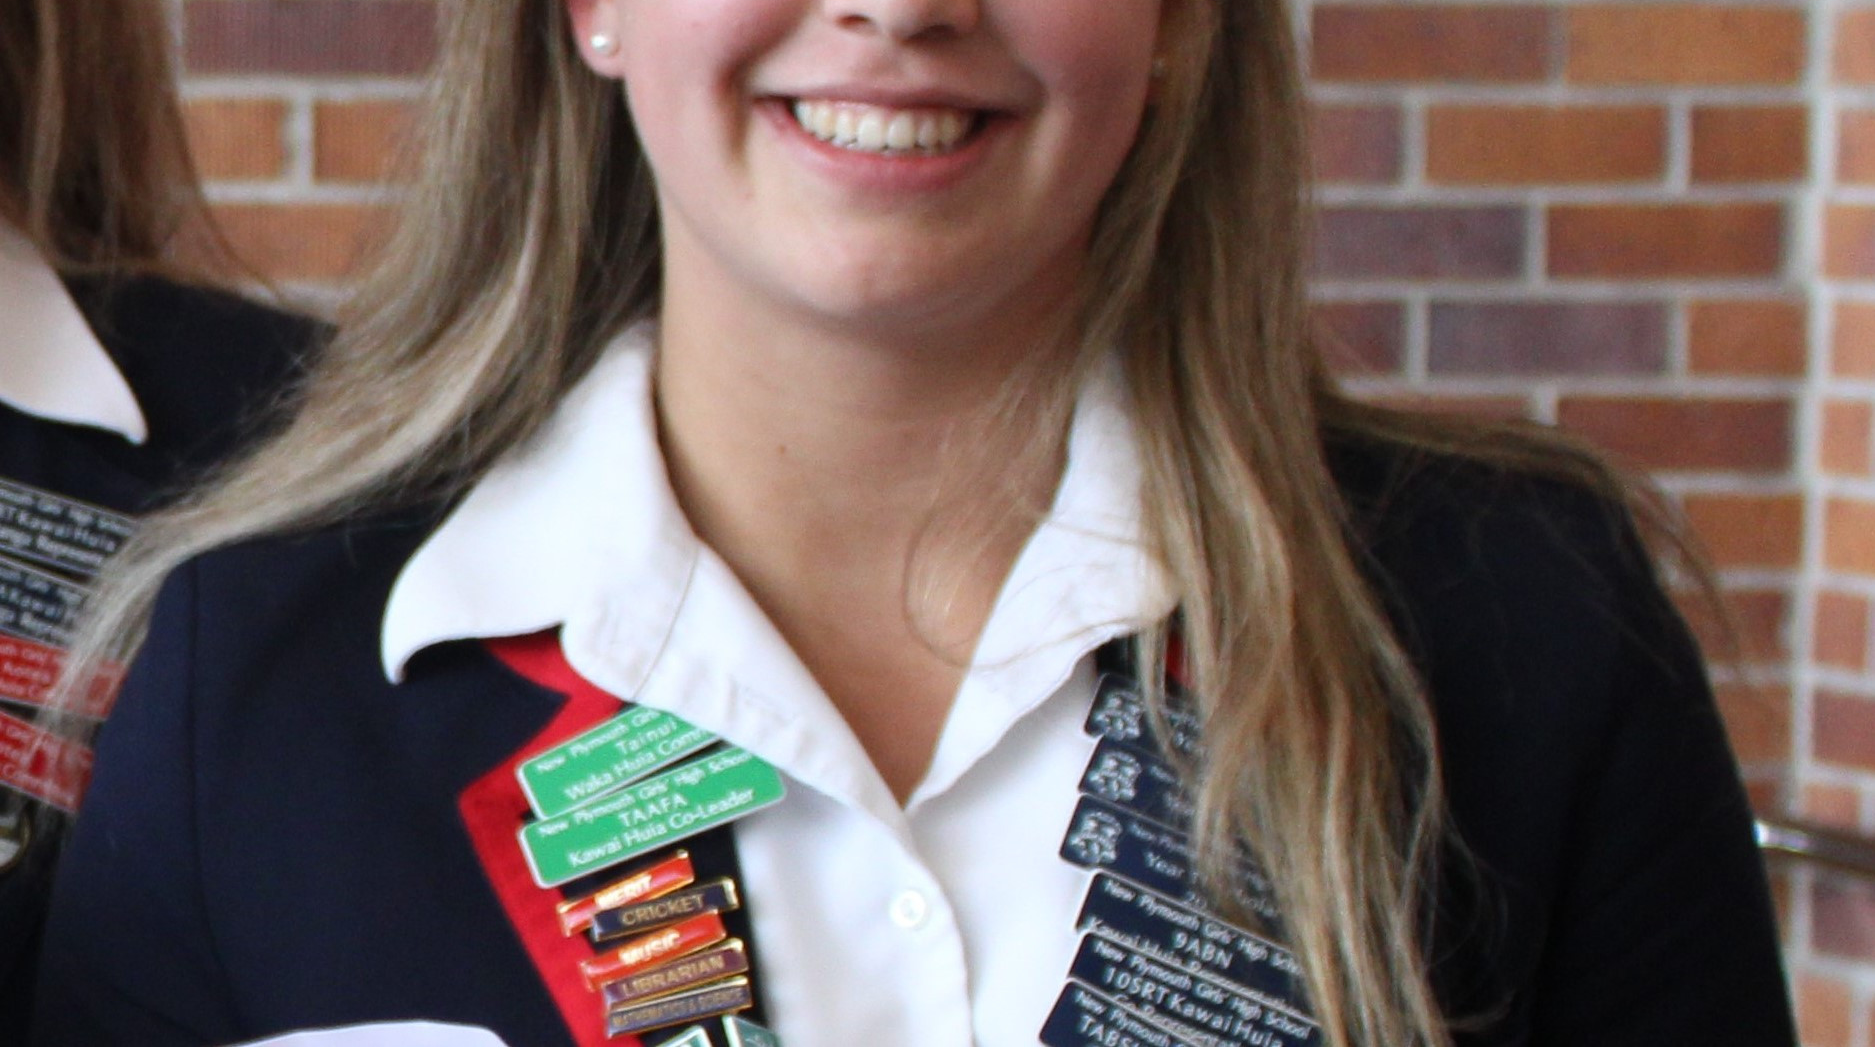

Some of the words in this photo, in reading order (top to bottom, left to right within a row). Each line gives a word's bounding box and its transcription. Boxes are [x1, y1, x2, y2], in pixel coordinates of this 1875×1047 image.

[536, 755, 566, 774] New
[569, 723, 630, 757] Plymouth
[616, 718, 679, 753] Tainui
[538, 819, 569, 838] New
[573, 793, 636, 825] Plymouth
[673, 766, 707, 788] High
[708, 751, 751, 775] School
[564, 773, 614, 801] Waka
[613, 751, 656, 778] Huia
[568, 834, 622, 867] Kawai
[622, 823, 668, 848] Huia
[669, 788, 755, 830] Co-Leader
[618, 792, 688, 828] TAAFA
[1144, 852, 1186, 878] Year
[620, 893, 705, 926] CRICKET
[1105, 879, 1137, 902] New
[1138, 894, 1200, 931] Plymouth
[1238, 937, 1269, 962] High
[1271, 952, 1304, 976] Scho
[621, 954, 725, 997] LIBRARIAN
[1174, 931, 1233, 970] 9ABN
[1094, 940, 1127, 963] New
[1129, 954, 1192, 991] Plymouth
[1194, 982, 1230, 1005] Girls'
[1229, 995, 1263, 1021] High
[1265, 1009, 1312, 1040] School
[1104, 966, 1170, 1004] 10SRT
[1168, 992, 1234, 1033] Kawai
[1232, 1019, 1284, 1047] Huia
[1075, 990, 1107, 1015] New
[1109, 1008, 1172, 1047] Plymouth
